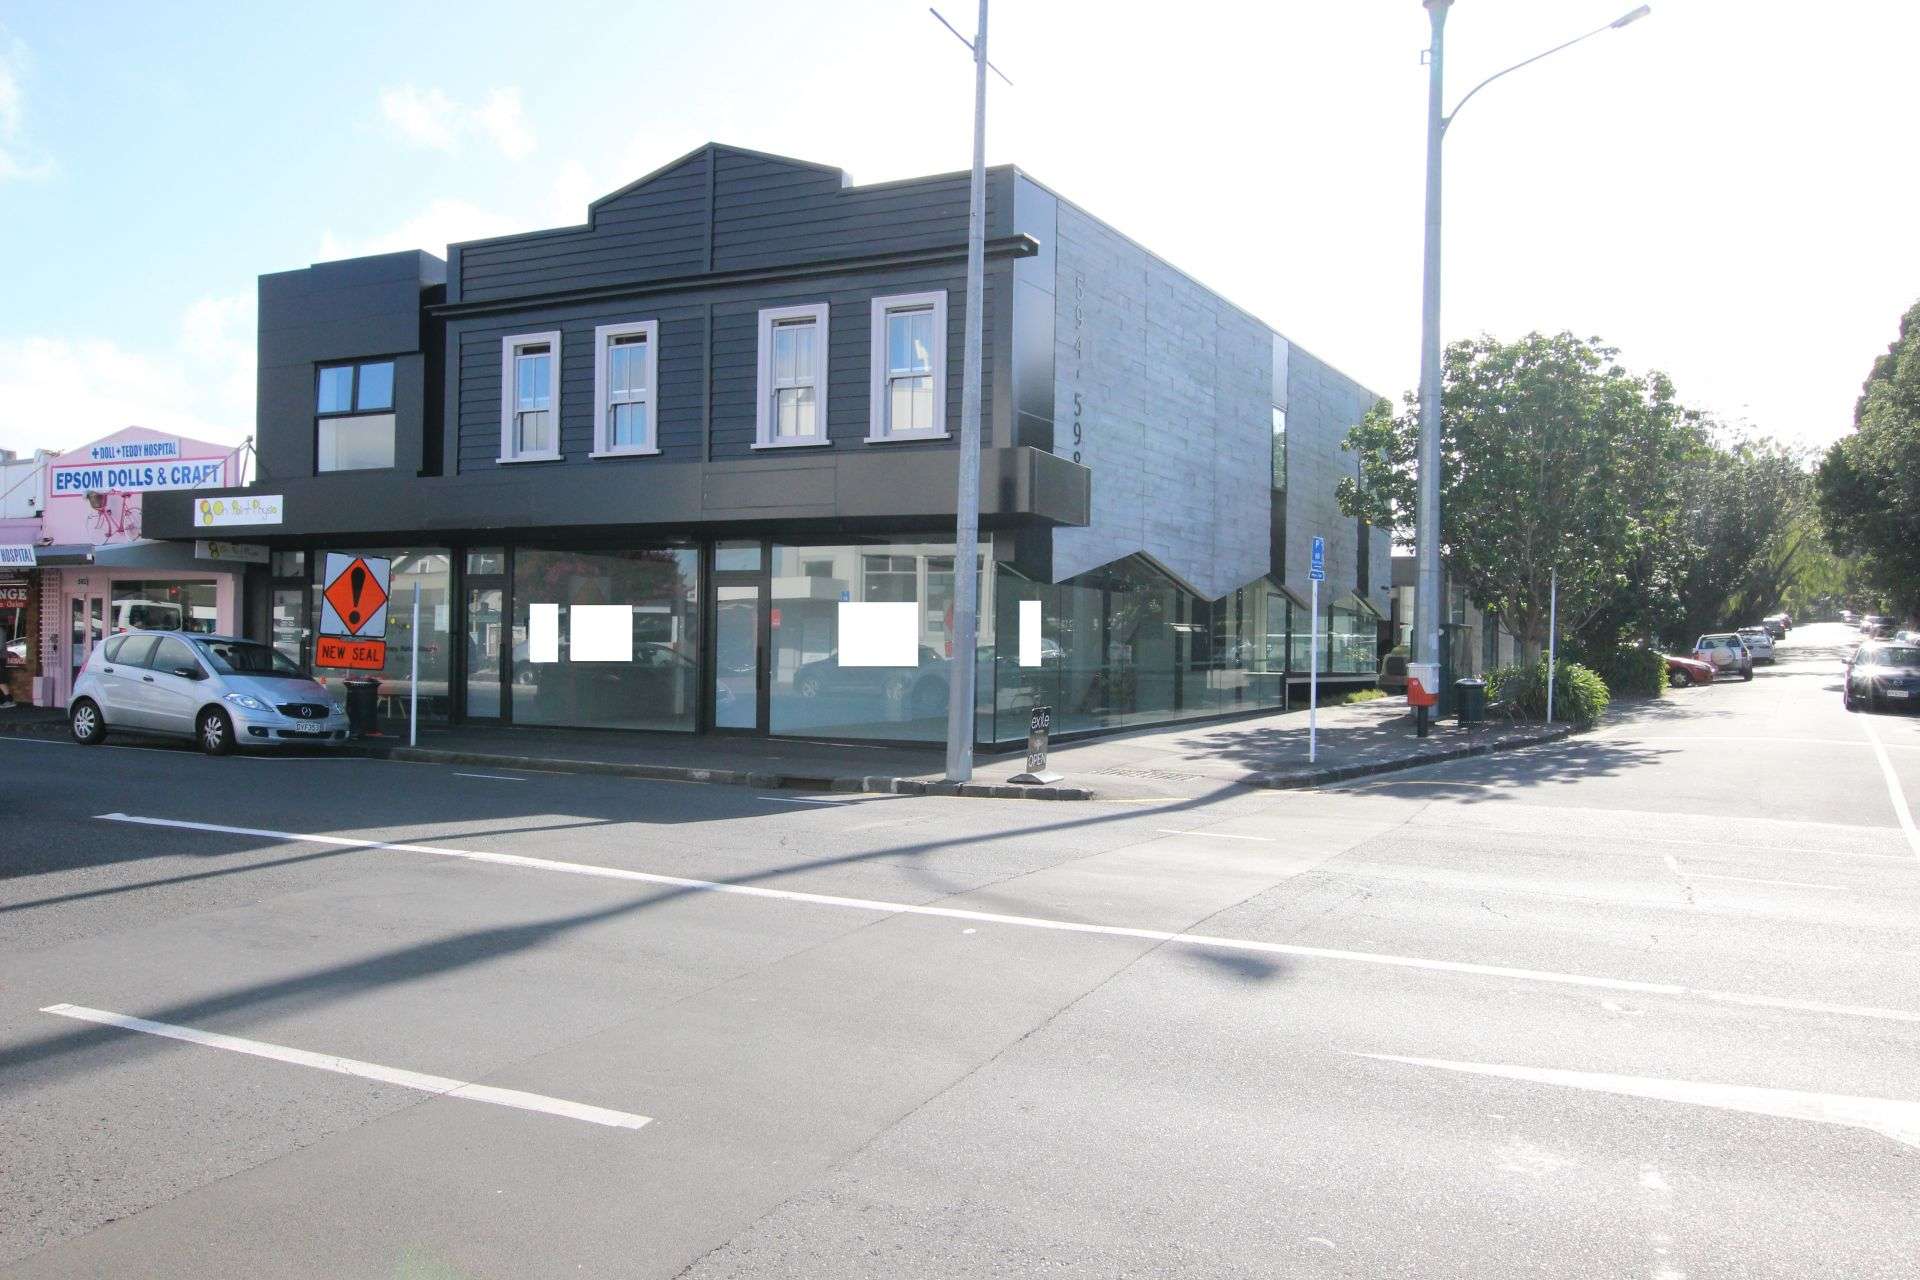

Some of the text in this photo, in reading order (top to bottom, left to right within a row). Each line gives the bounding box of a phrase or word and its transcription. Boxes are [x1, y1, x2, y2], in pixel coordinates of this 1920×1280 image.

[100, 447, 115, 459] DOLL
[121, 445, 143, 458] TEDDY
[143, 442, 176, 457] HOSPITAL
[56, 464, 219, 490] EPSOM DOLLS & CRAFT
[0, 549, 33, 562] HOSPITAL
[322, 645, 345, 660] NEW
[352, 647, 379, 662] SEAL
[1028, 753, 1047, 768] OPEN
